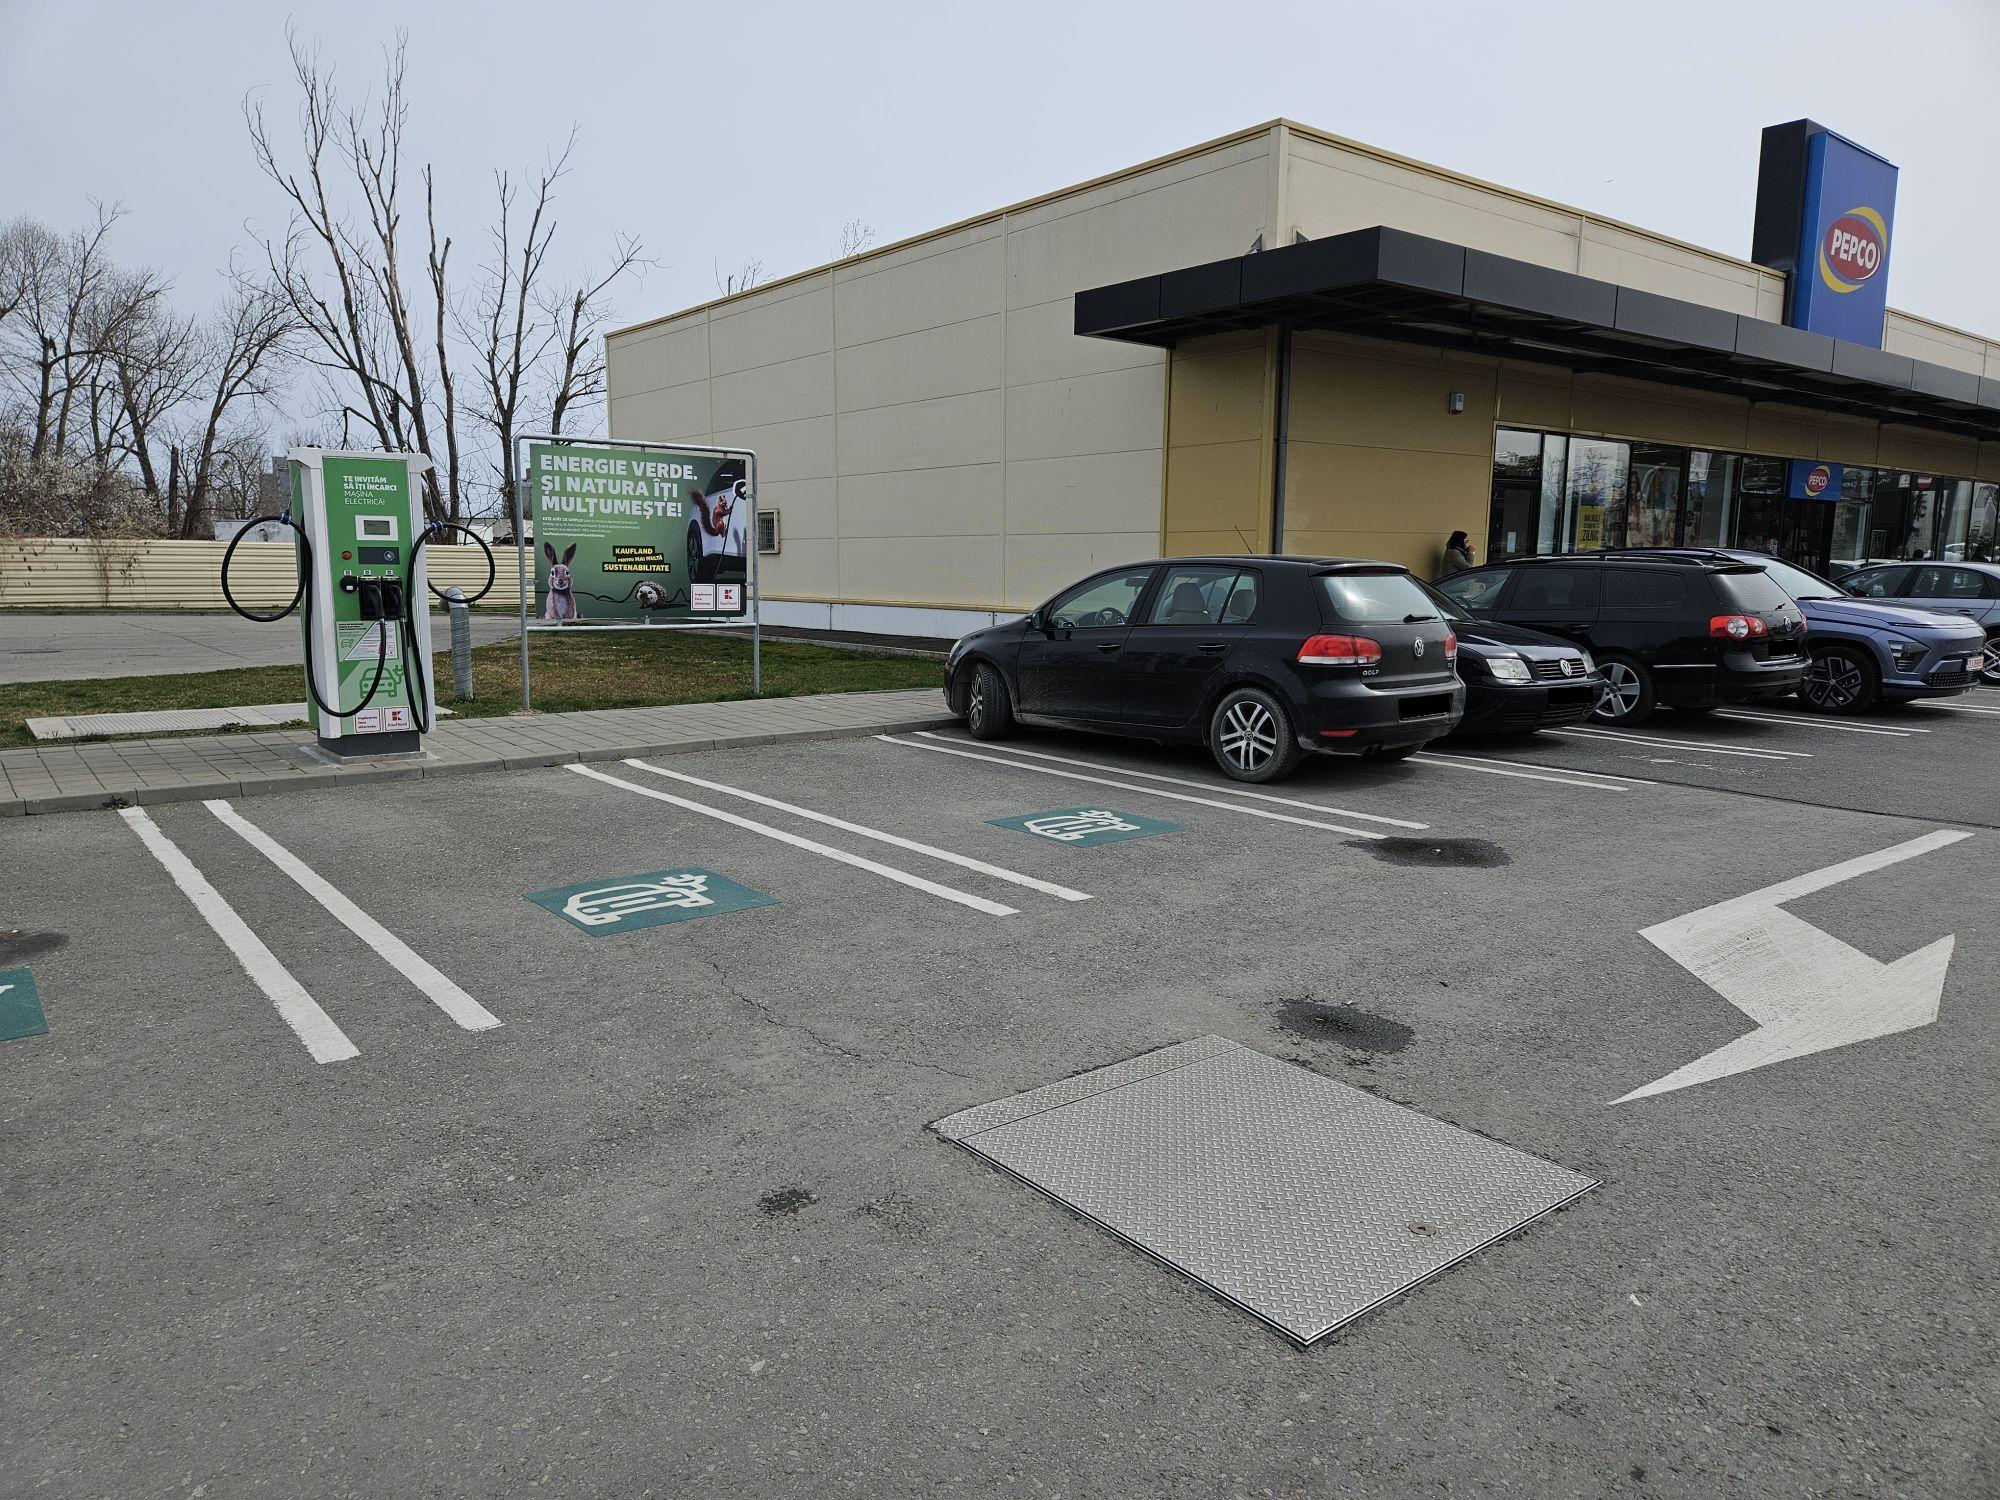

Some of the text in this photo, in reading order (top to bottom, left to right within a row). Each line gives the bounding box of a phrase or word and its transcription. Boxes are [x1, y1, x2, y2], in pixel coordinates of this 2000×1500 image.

[1831, 228, 1877, 269] PEPCO
[540, 454, 698, 480] ENERGIE VERDE.
[354, 475, 387, 483] INVITĂM
[1809, 475, 1827, 486] PEPCO
[343, 481, 397, 491] SĂ ÎȚI ÎNCARCI
[541, 475, 678, 501] ȘI NATURA ÎȚI
[344, 490, 374, 498] MAȘINA
[541, 496, 682, 520] MULȚUMEȘTE!
[603, 563, 670, 571] SUSTENABILITATE
